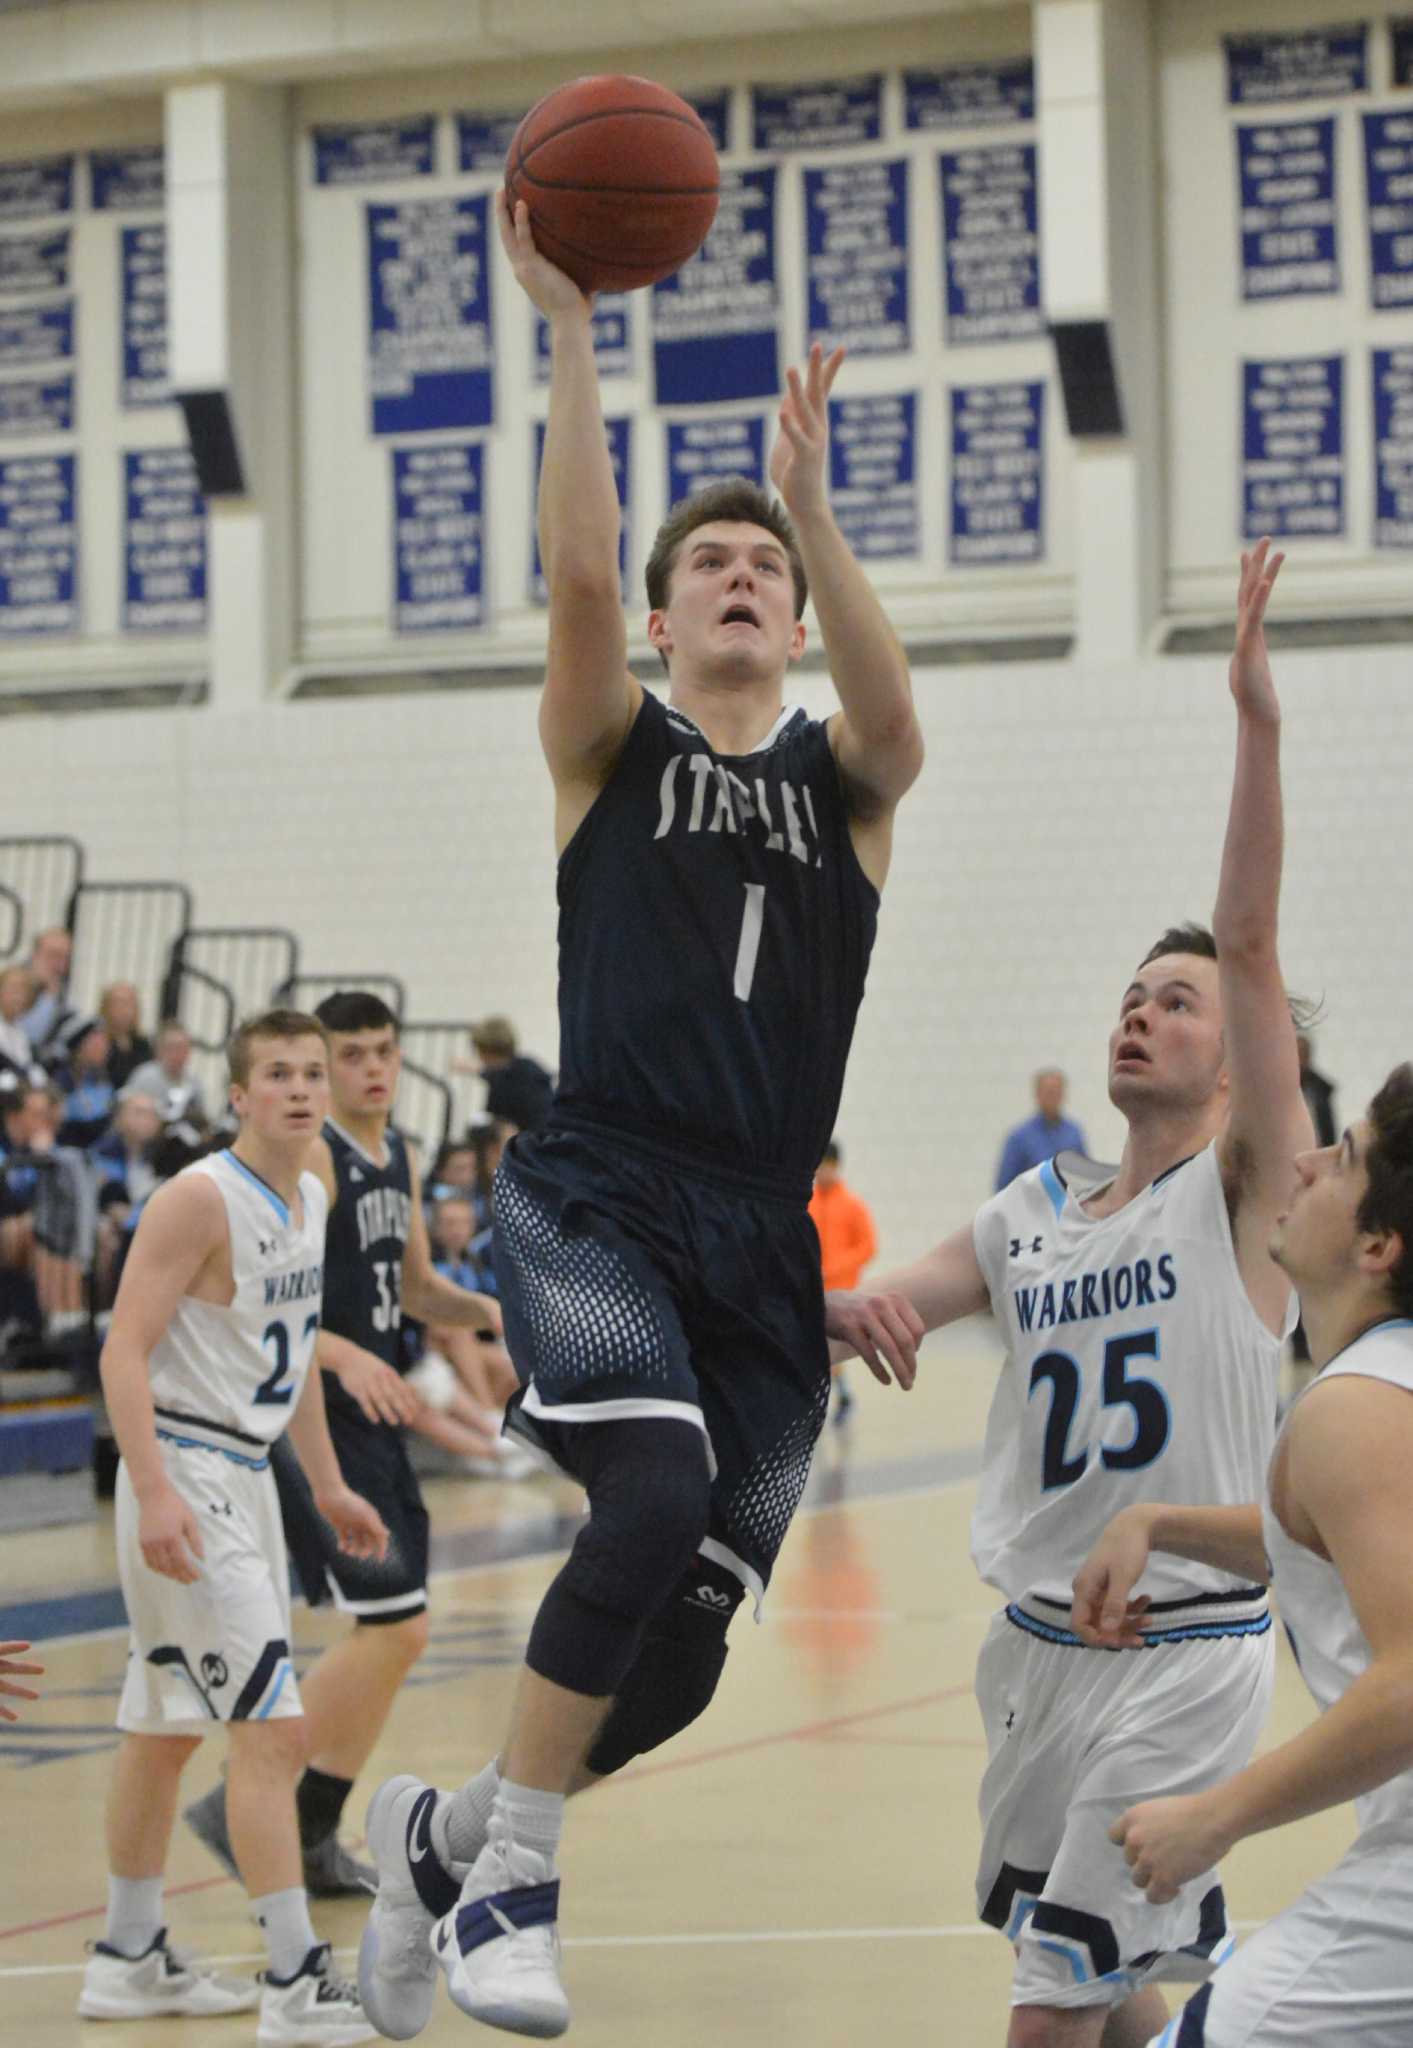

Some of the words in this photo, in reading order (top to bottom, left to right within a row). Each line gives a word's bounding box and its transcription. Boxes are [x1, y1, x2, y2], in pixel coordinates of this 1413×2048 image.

[733, 882, 765, 1002] 1
[1014, 1253, 1177, 1333] WARRIORS
[1028, 1327, 1171, 1494] 25
